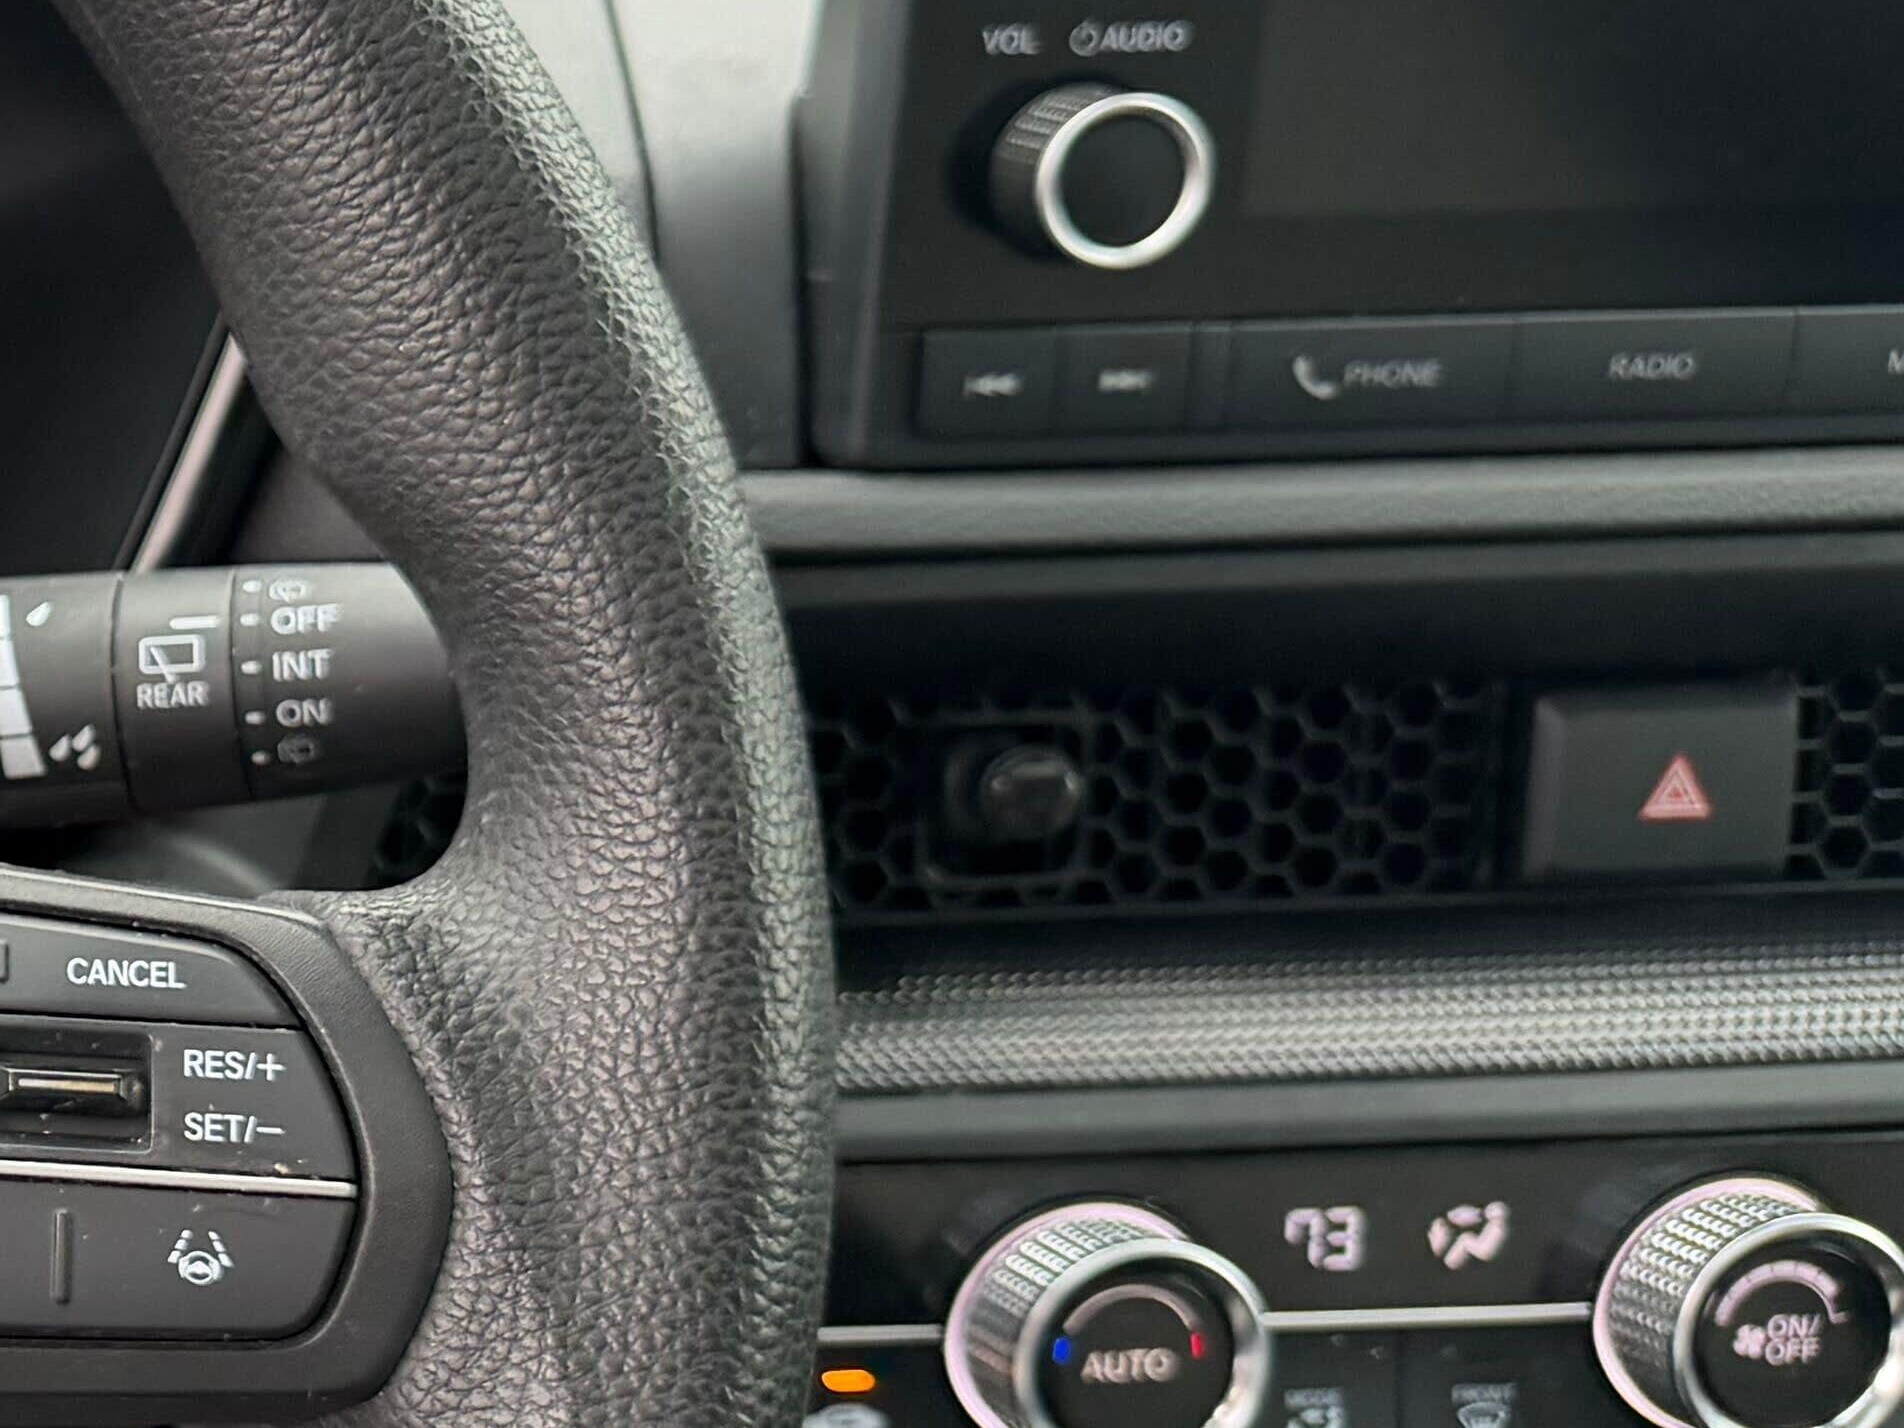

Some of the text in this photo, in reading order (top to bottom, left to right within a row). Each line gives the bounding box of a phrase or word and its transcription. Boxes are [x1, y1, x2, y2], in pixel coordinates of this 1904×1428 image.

[982, 24, 1041, 56] VOL
[1099, 20, 1192, 53] AUDIO
[1342, 357, 1442, 389] PHONE
[1608, 350, 1696, 381] RADIO
[270, 603, 340, 635] OFF
[272, 648, 334, 682] INT
[136, 680, 210, 710] REAR
[275, 698, 333, 728] ON
[66, 957, 187, 991] CANCEL
[1080, 1348, 1173, 1383] AUTO
[1765, 1337, 1822, 1366] OFF
